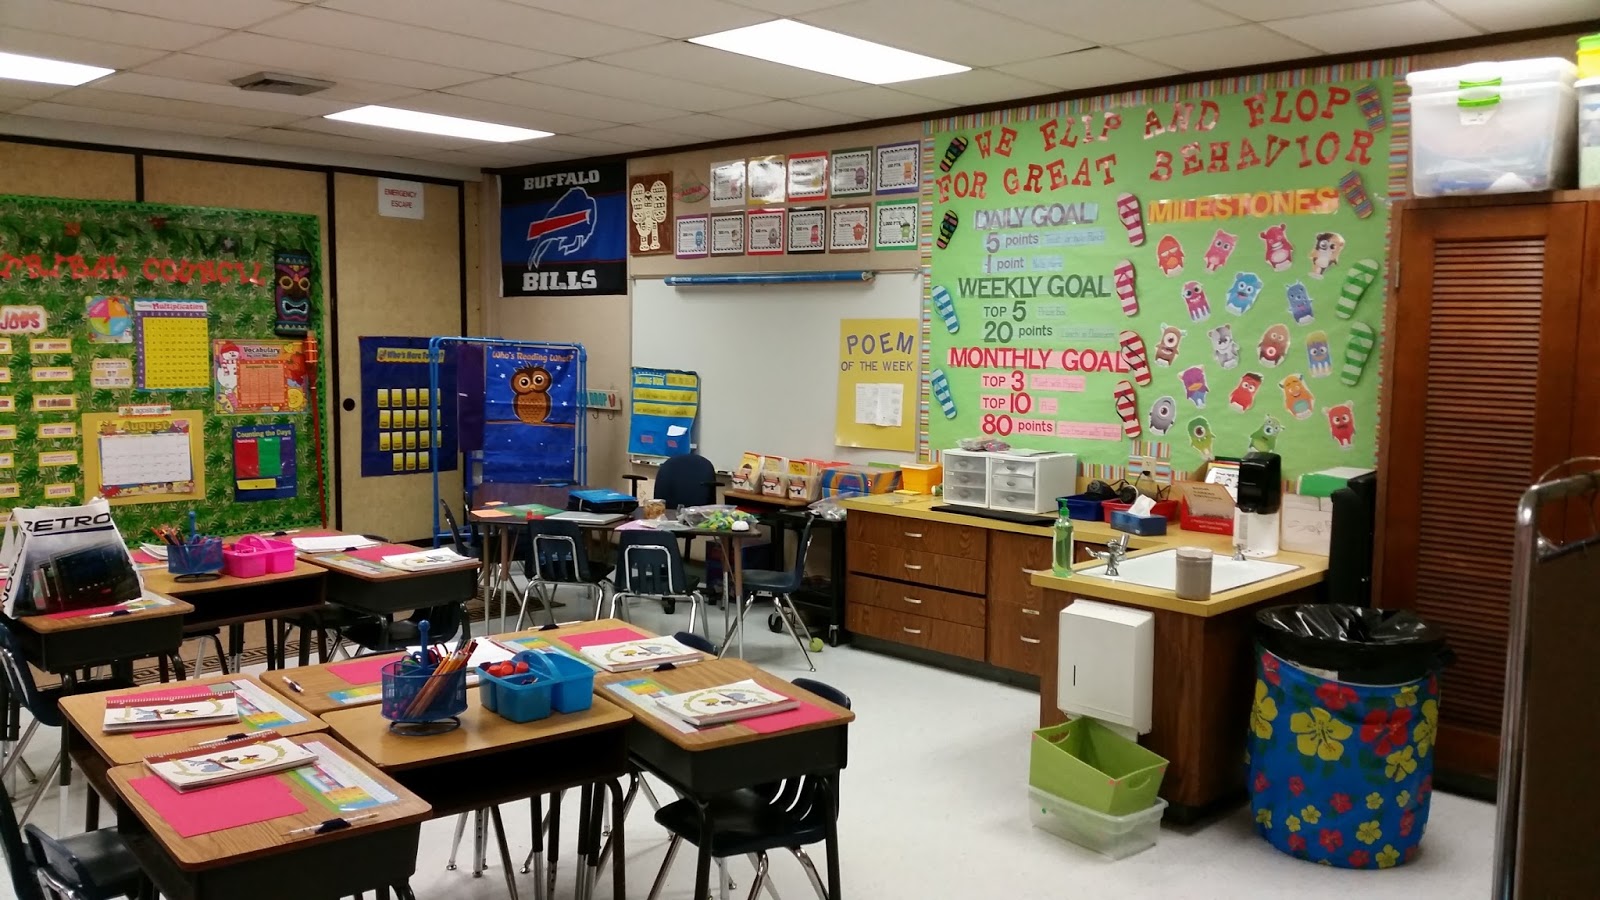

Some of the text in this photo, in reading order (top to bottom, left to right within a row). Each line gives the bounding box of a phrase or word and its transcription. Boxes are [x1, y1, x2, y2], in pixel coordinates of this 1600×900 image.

[975, 86, 1351, 159] WE FLIP AND FLOP
[936, 129, 1375, 204] FOR GREAT BEHAVIOR
[523, 169, 600, 191] BUFFALO
[384, 188, 417, 198] EMERGENCY
[391, 200, 413, 208] ESCAPE
[975, 202, 1094, 230] DAILY GOAL
[1149, 187, 1340, 224] MILESTONES
[986, 232, 1000, 253] 5
[1005, 232, 1039, 248] points
[0, 252, 265, 286] TRIBAL COUNCIL
[997, 257, 1024, 271] point
[522, 269, 598, 292] BILLS
[958, 274, 1111, 299] WEEKLY GOAL
[152, 302, 204, 310] Multiplication
[984, 306, 1007, 318] TOP
[1012, 300, 1027, 322] 5
[846, 331, 914, 355] POEM
[984, 320, 1013, 344] 20
[1018, 325, 1053, 341] points
[492, 351, 514, 360] Who's
[516, 352, 548, 363] Reading
[840, 361, 913, 372] OF THE WEEK
[949, 346, 1130, 373] MONTHLY GOAL
[983, 375, 1005, 387] TOP
[1010, 370, 1025, 392] 3
[983, 397, 1005, 409] TOP
[1010, 392, 1031, 414] 10
[122, 421, 171, 433] August
[982, 413, 1012, 437] 80
[1018, 418, 1053, 434] points
